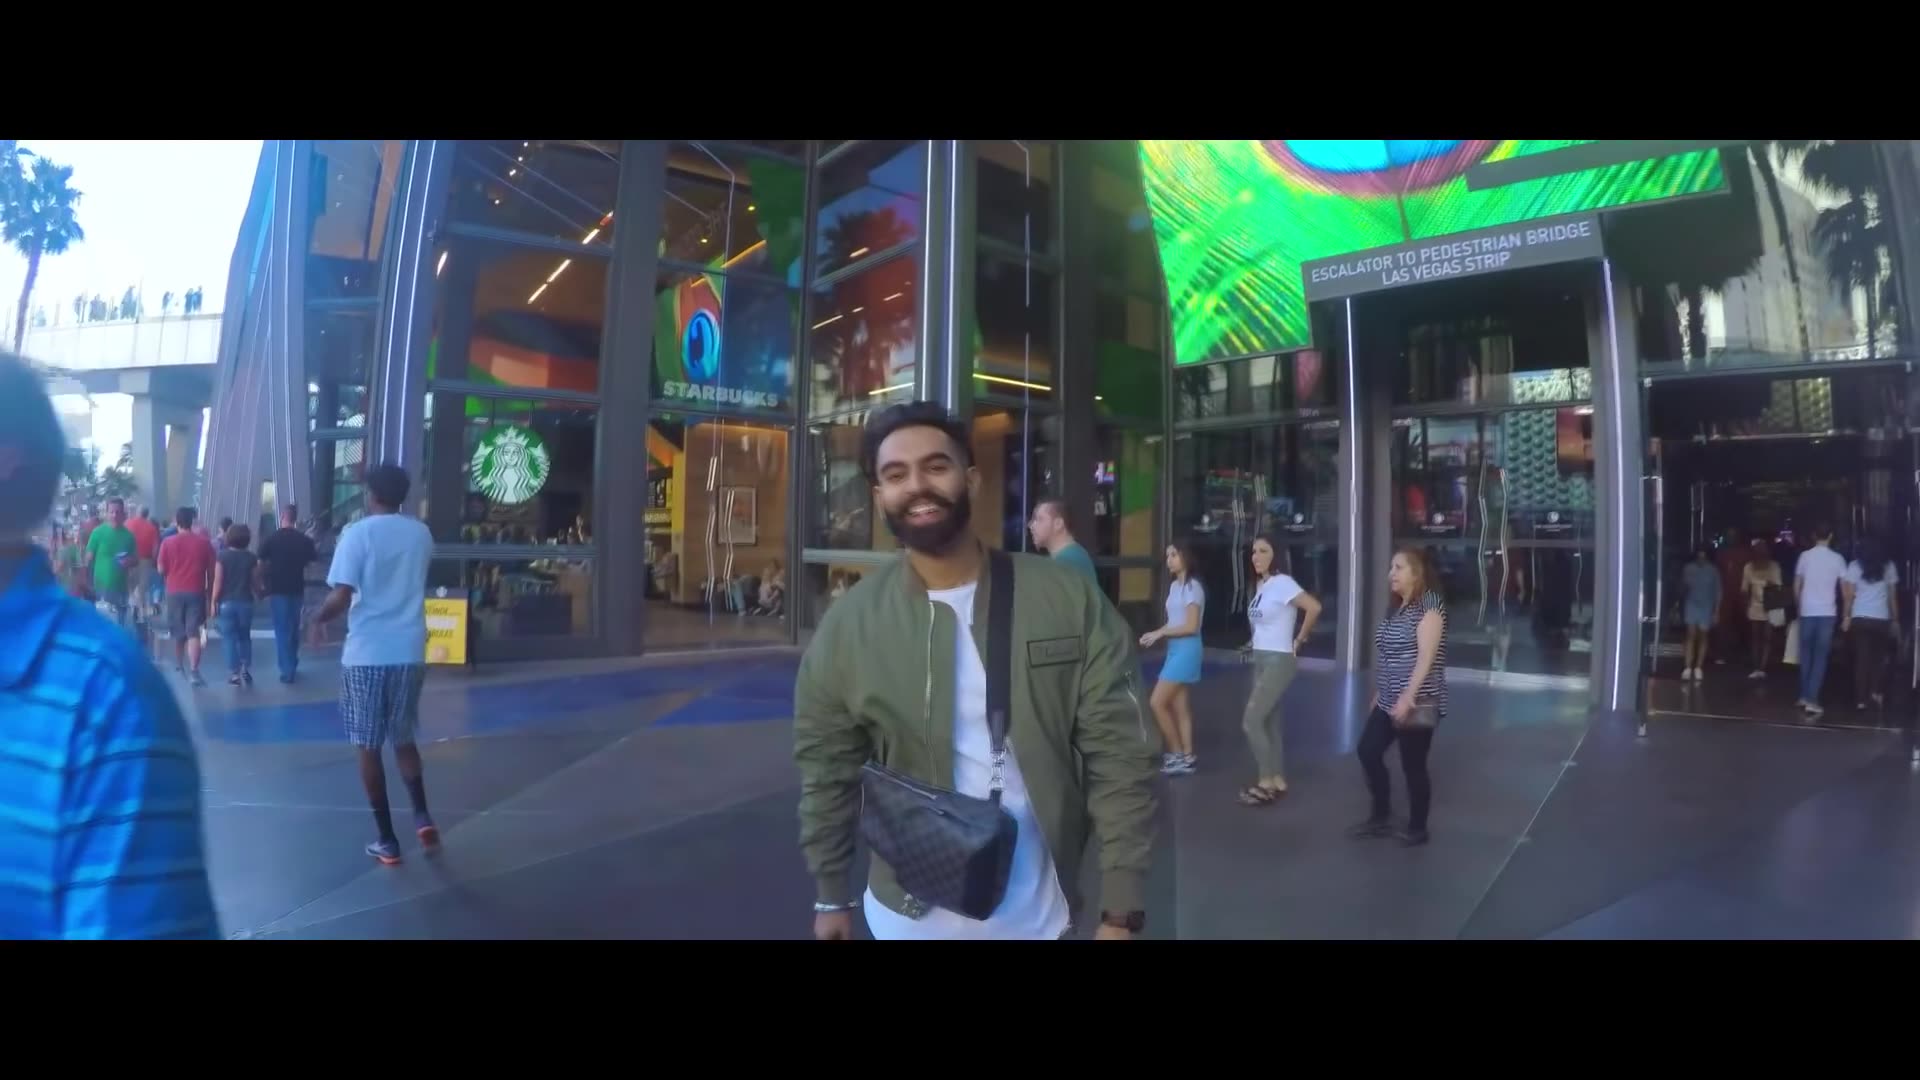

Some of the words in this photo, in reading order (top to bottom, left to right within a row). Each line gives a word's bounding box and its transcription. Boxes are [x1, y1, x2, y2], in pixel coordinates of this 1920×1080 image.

[1312, 255, 1393, 283] ESCALATOR
[1397, 249, 1416, 267] TO
[1420, 233, 1522, 263] PEDESTRIAN
[1526, 221, 1592, 246] BRIDGE
[1382, 267, 1410, 285] LAS
[1413, 258, 1462, 281] VEGAS
[1465, 251, 1512, 273] STRIP
[663, 380, 779, 407] STARBUCKS
